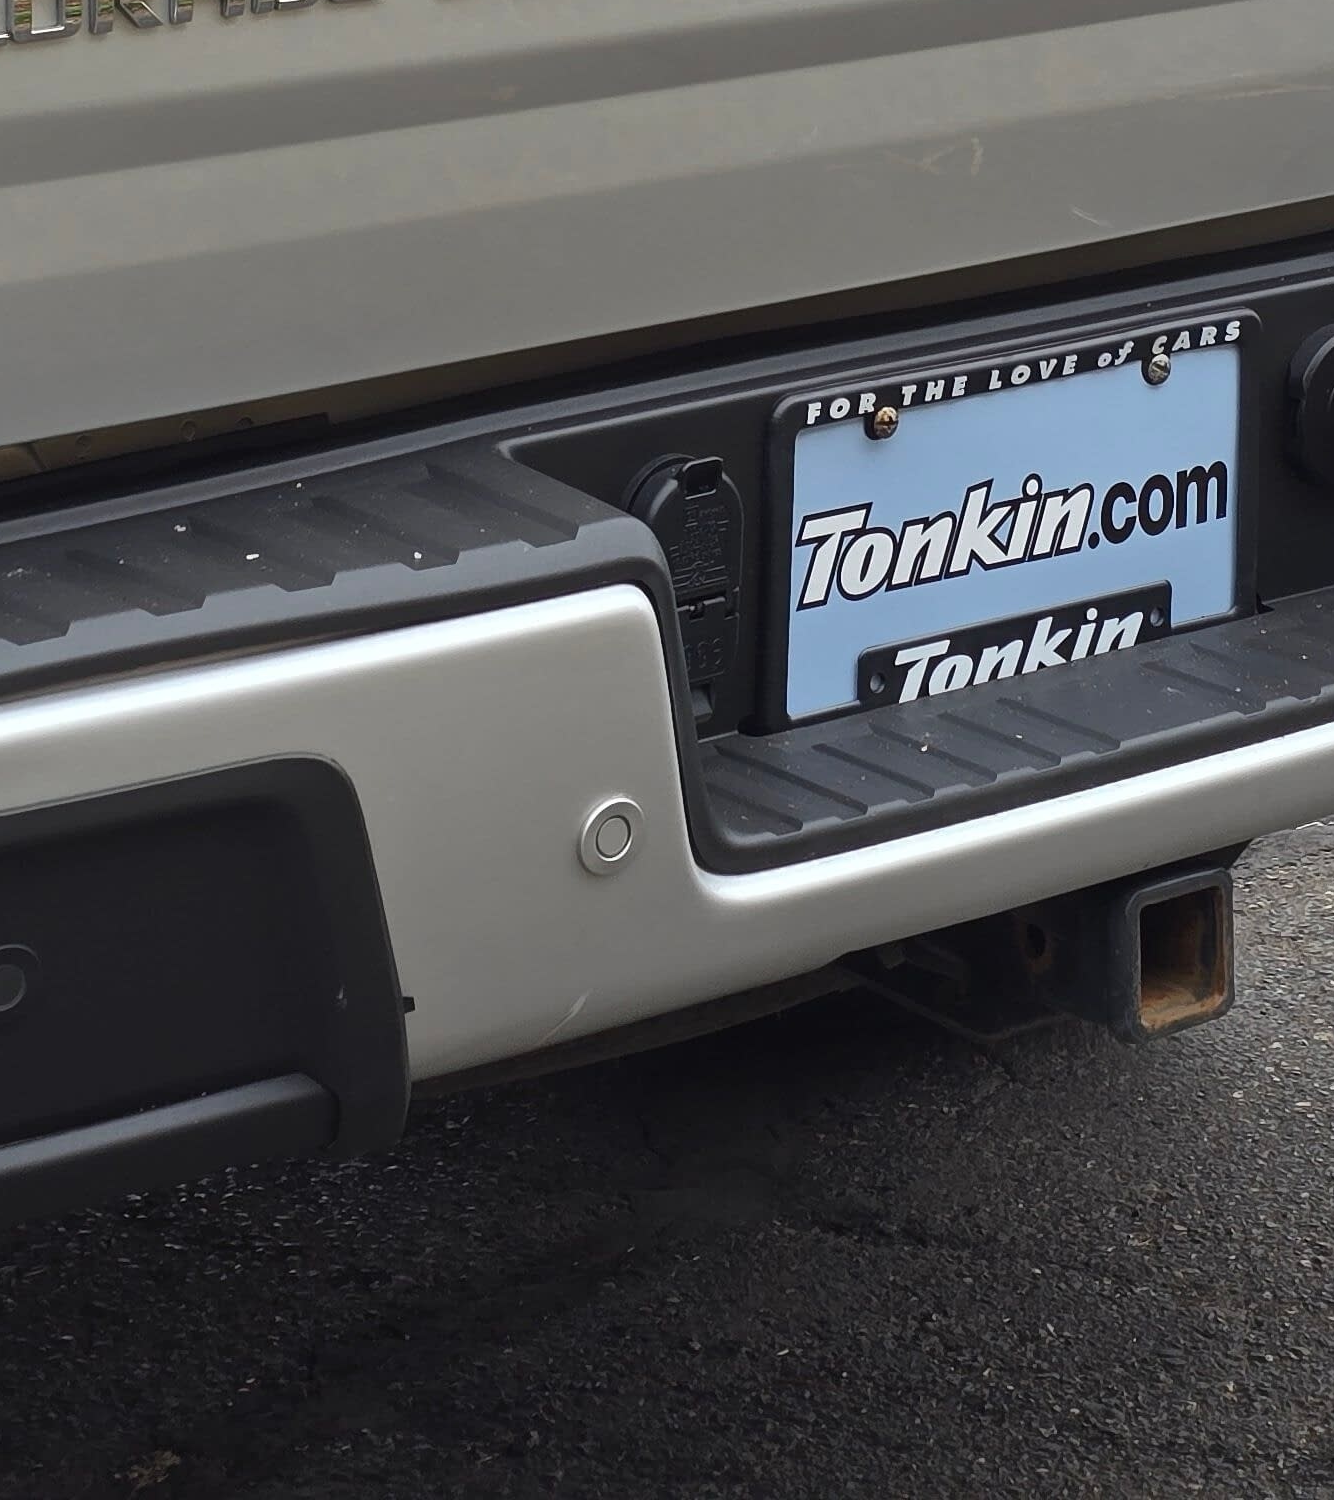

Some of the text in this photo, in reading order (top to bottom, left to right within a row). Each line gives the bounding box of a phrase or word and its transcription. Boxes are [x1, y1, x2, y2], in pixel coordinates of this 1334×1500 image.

[806, 320, 1241, 425] FOR THE LOVE of CARS
[794, 460, 1228, 611] Tonkin.com
[894, 607, 1144, 704] Tonkin
